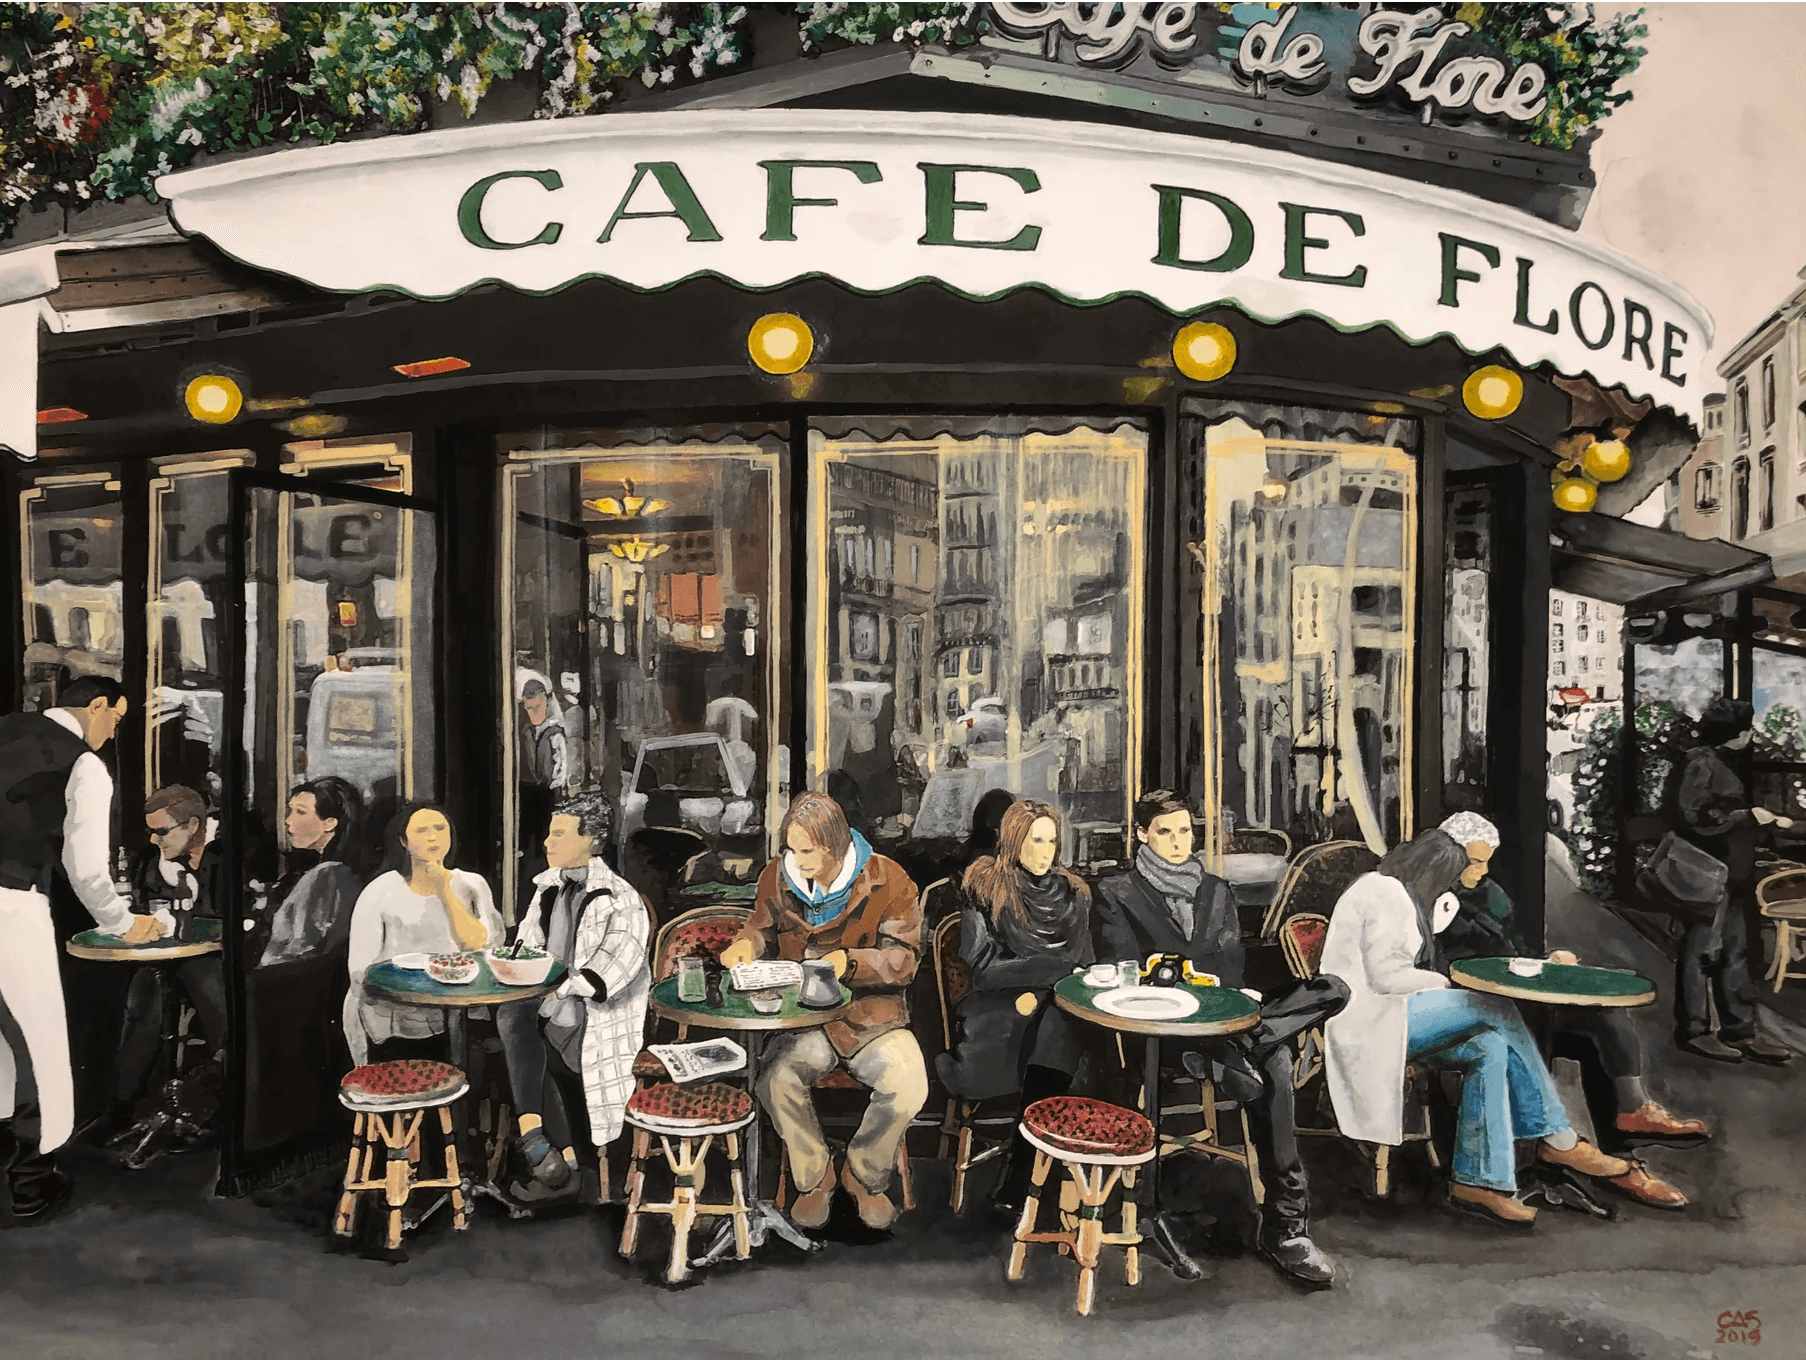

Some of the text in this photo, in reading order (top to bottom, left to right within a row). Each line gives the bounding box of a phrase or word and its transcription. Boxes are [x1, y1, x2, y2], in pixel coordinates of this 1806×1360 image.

[1238, 6, 1325, 79] de
[1347, 8, 1547, 122] Flore
[457, 160, 1688, 388] CAFE DE FLORE
